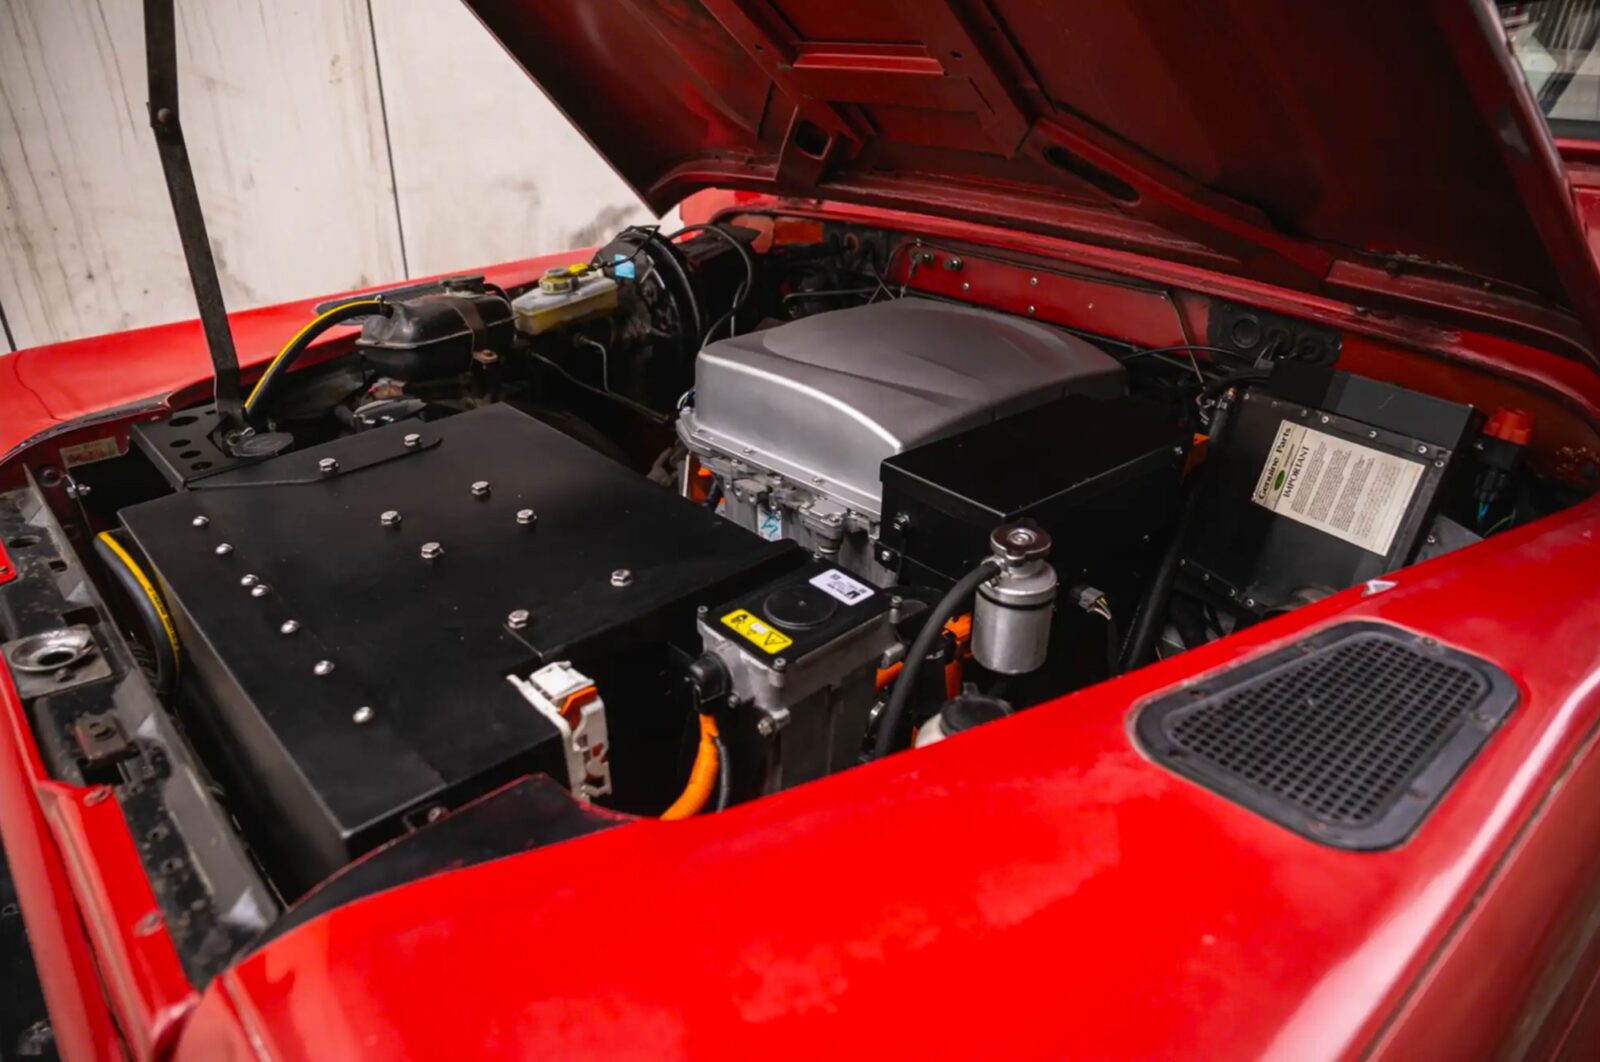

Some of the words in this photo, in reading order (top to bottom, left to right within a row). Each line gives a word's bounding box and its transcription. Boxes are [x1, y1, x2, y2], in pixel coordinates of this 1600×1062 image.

[1259, 457, 1279, 499] Genuine
[1276, 428, 1291, 454] Parts
[1283, 445, 1309, 498] IMPORTANT
